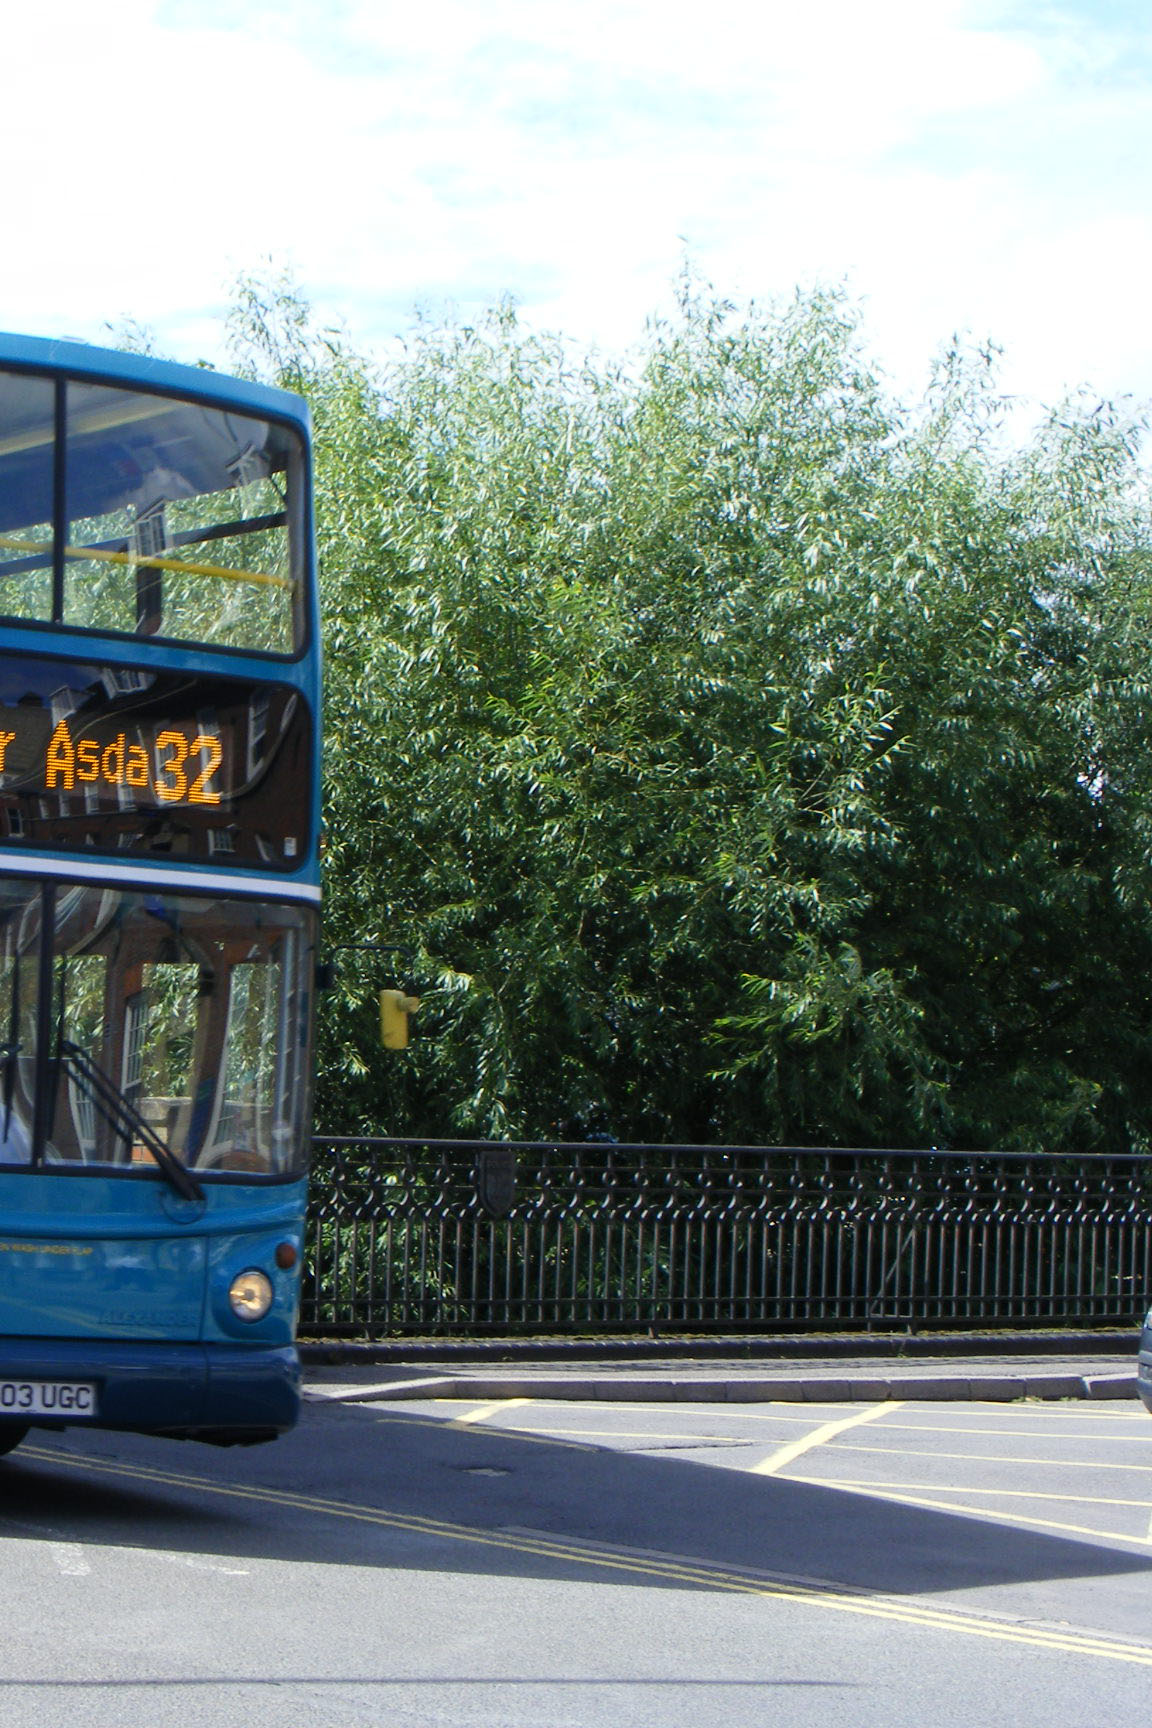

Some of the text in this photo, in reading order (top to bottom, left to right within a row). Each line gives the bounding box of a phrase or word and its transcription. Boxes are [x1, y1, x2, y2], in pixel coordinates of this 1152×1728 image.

[45, 719, 149, 790] Asda
[153, 730, 222, 804] 32
[41, 1385, 90, 1409] UGC
